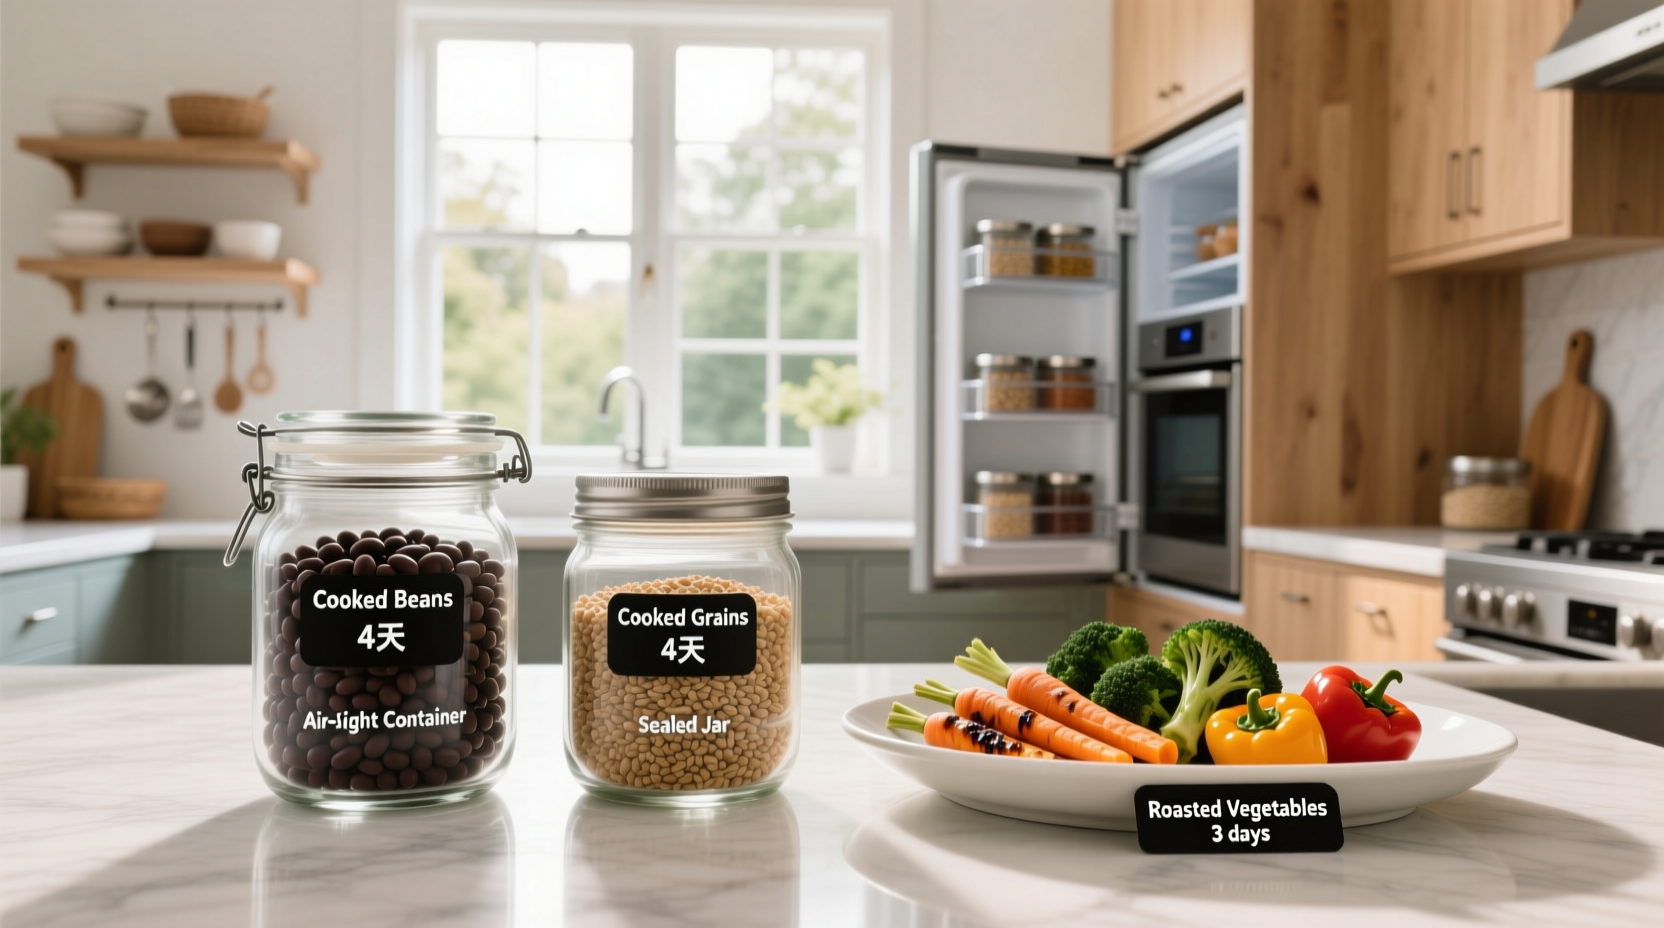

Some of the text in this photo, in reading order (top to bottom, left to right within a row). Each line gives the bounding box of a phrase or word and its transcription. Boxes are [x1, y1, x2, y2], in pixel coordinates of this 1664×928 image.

[312, 588, 454, 611] Cooked Beans
[617, 606, 749, 627] Cooked Grains
[357, 621, 406, 653] 4天
[660, 635, 706, 665] 4天
[383, 706, 467, 729] Container
[638, 714, 731, 734] Sealed Jar
[1148, 796, 1327, 820] Roasted Vegetables
[1211, 823, 1271, 846] 3 days
